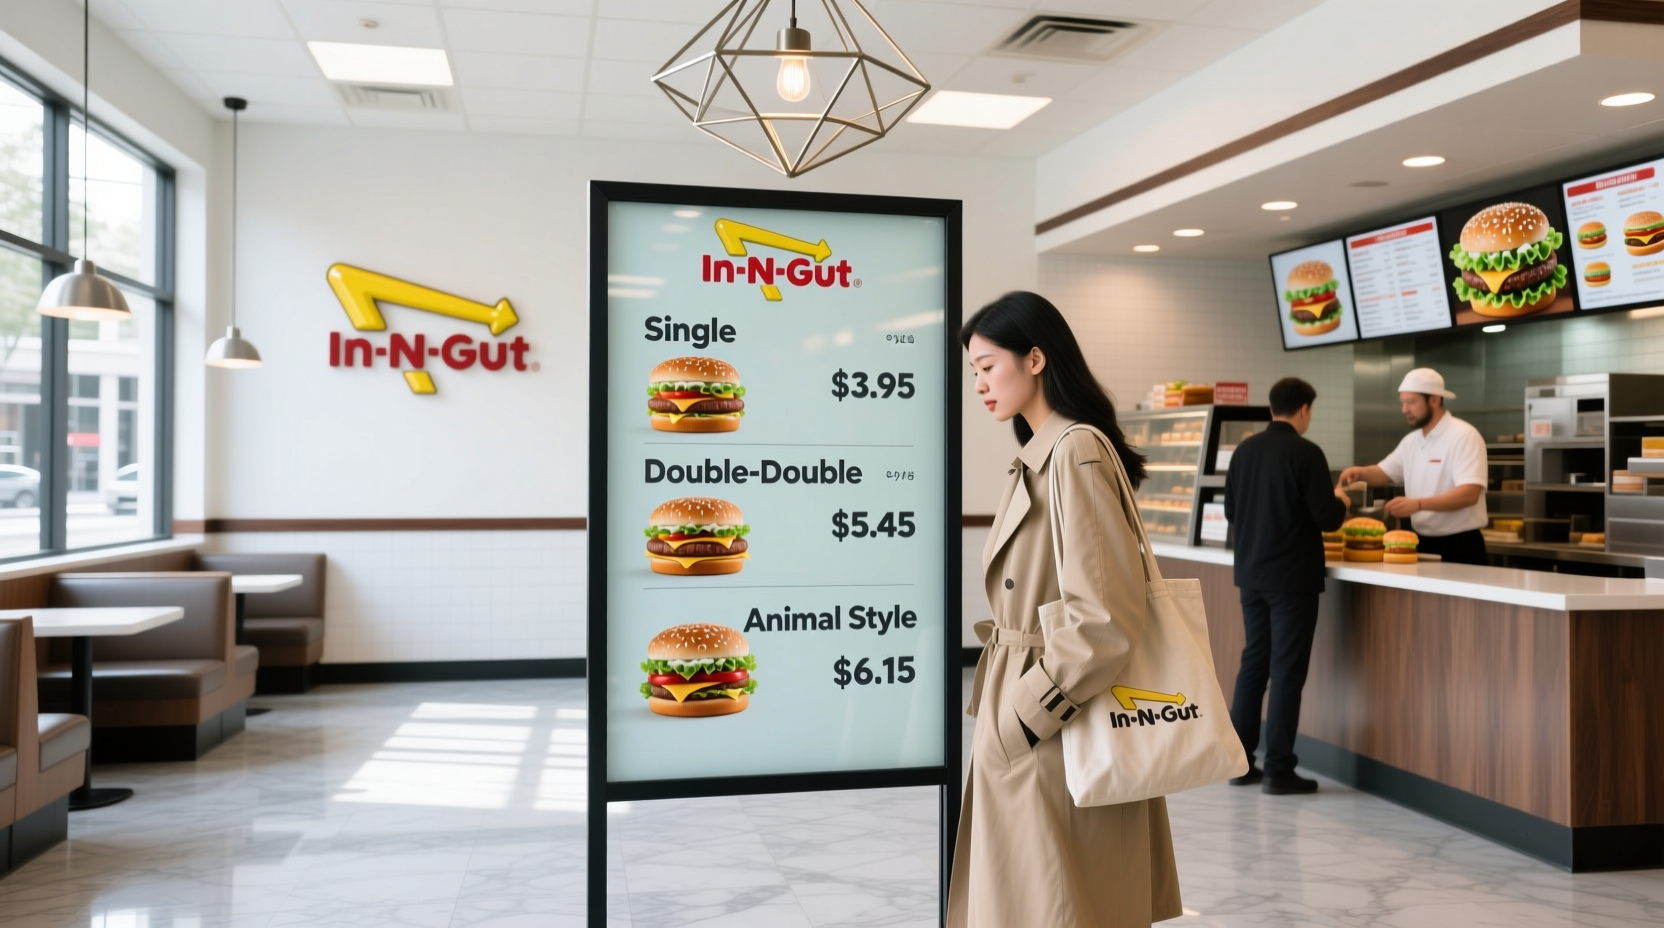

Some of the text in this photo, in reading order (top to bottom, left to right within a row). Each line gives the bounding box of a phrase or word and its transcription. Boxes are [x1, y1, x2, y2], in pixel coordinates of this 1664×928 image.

[701, 254, 853, 288] In-N-Gut
[644, 315, 737, 349] Single
[329, 331, 530, 372] In-N-Gut
[831, 368, 916, 402] $3.95
[644, 458, 863, 485] Double-Double
[831, 508, 916, 543] $5.45
[743, 604, 918, 636] Animal Style
[833, 655, 916, 690] $6.15
